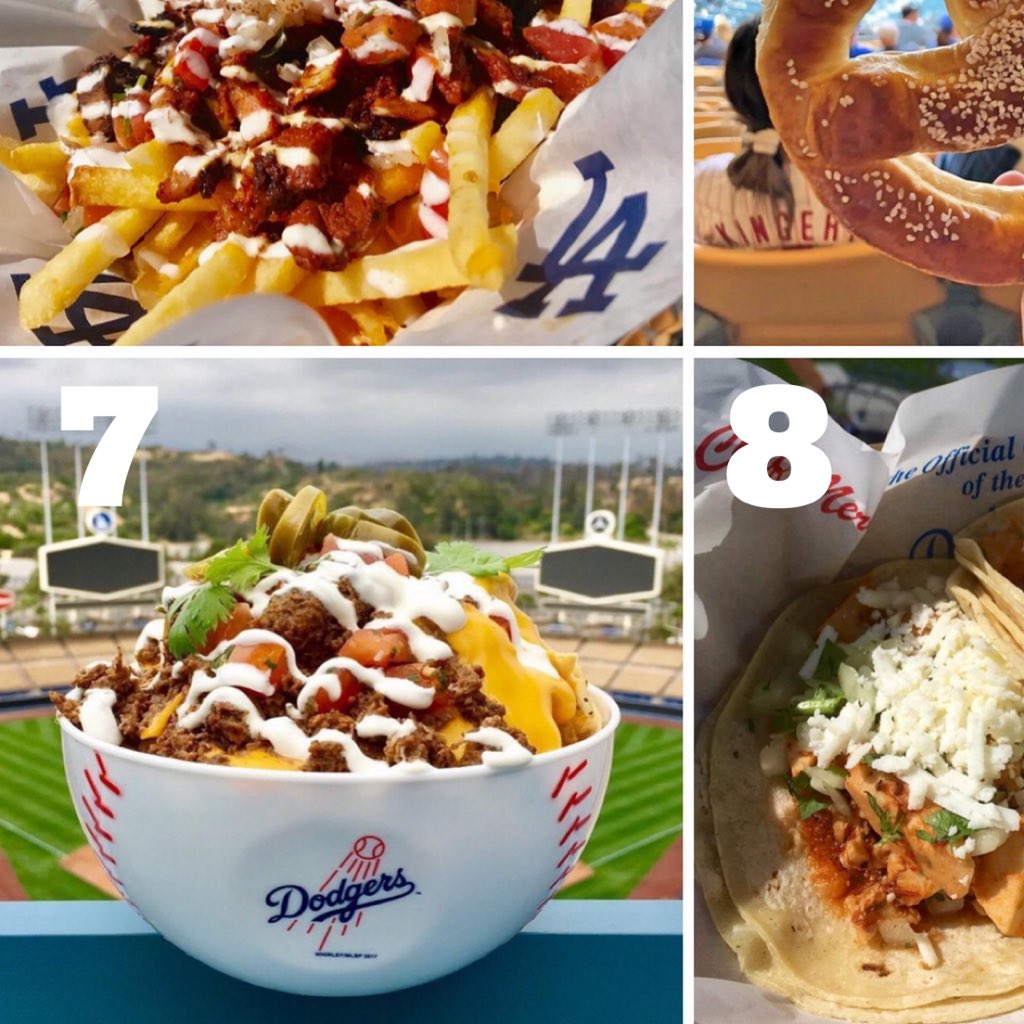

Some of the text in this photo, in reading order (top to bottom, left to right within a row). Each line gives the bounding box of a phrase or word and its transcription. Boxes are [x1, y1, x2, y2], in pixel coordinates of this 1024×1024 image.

[493, 150, 669, 320] LA
[921, 435, 1016, 476] Official
[961, 471, 987, 500] of
[264, 867, 416, 924] Dodgers
